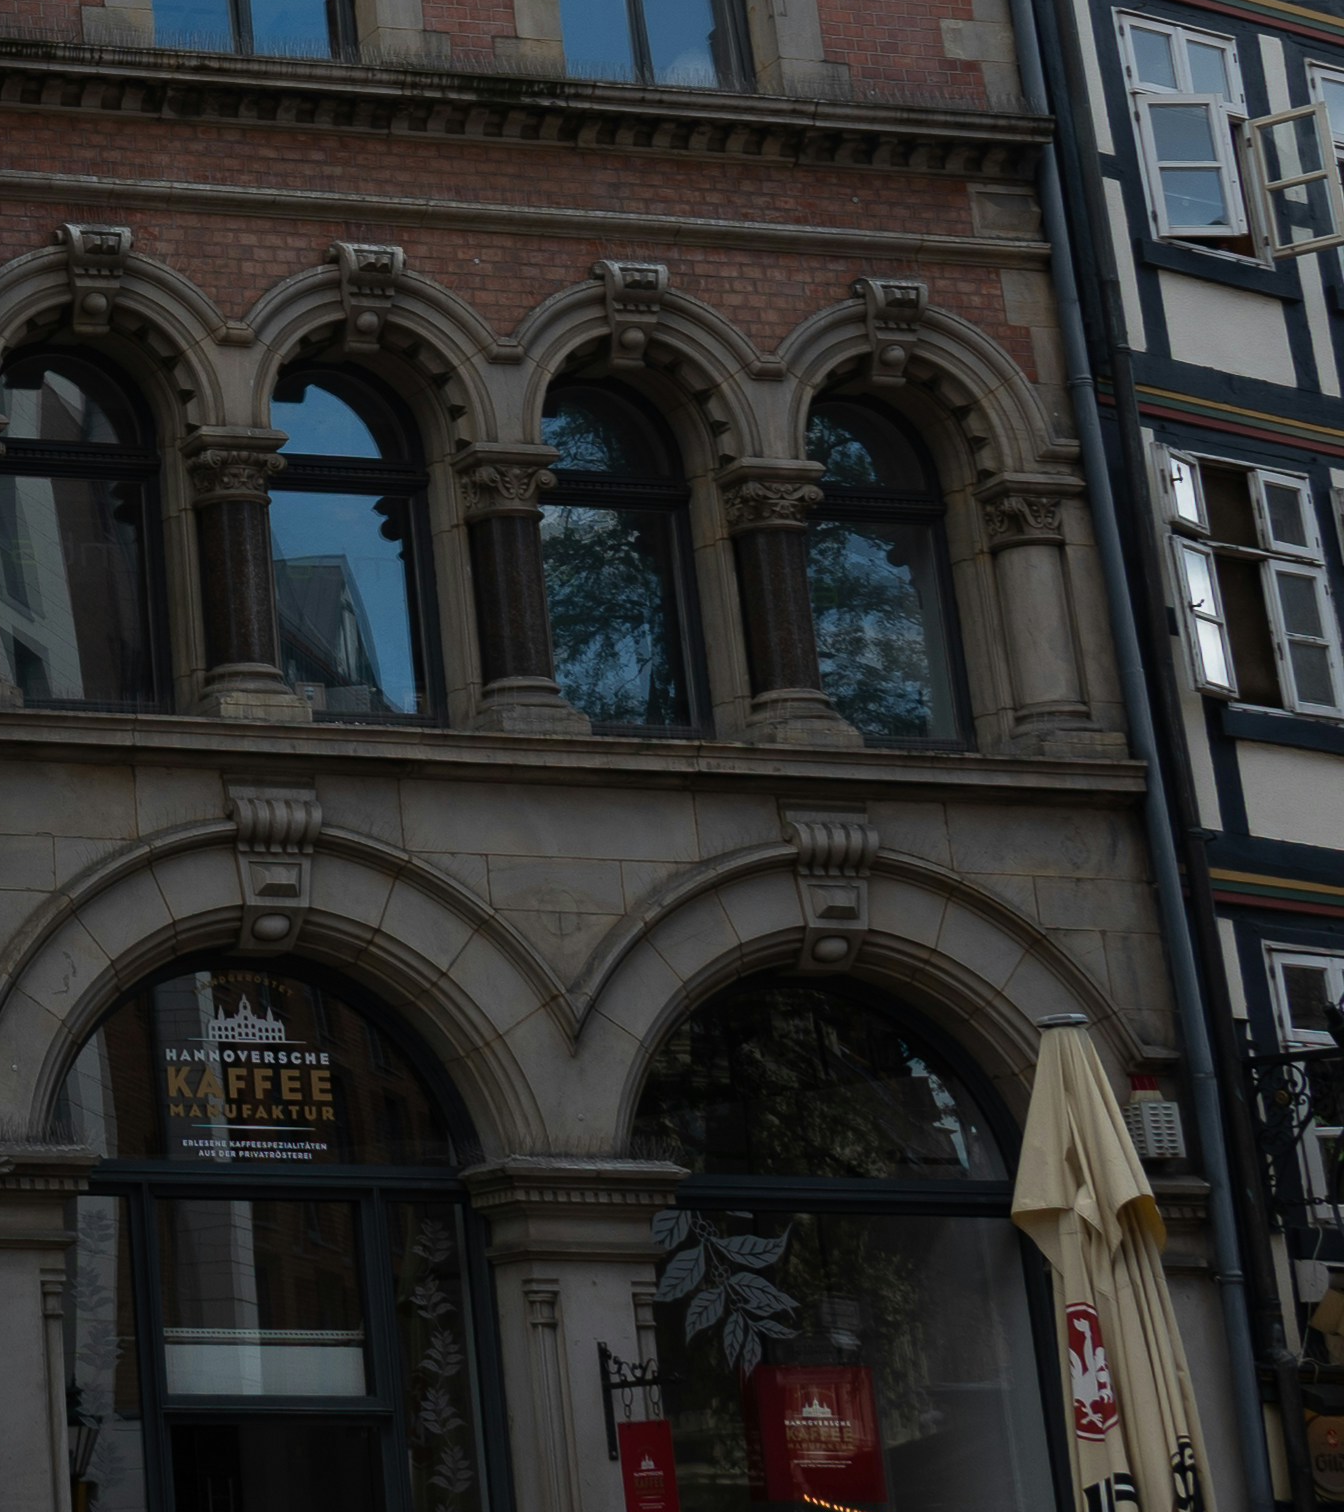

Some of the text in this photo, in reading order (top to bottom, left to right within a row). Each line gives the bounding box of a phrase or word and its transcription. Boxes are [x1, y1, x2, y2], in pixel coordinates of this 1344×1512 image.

[165, 1048, 330, 1066] HANNOVERSCHE
[166, 1065, 334, 1102] KAFFEE
[169, 1103, 336, 1121] MANUFAKTUR
